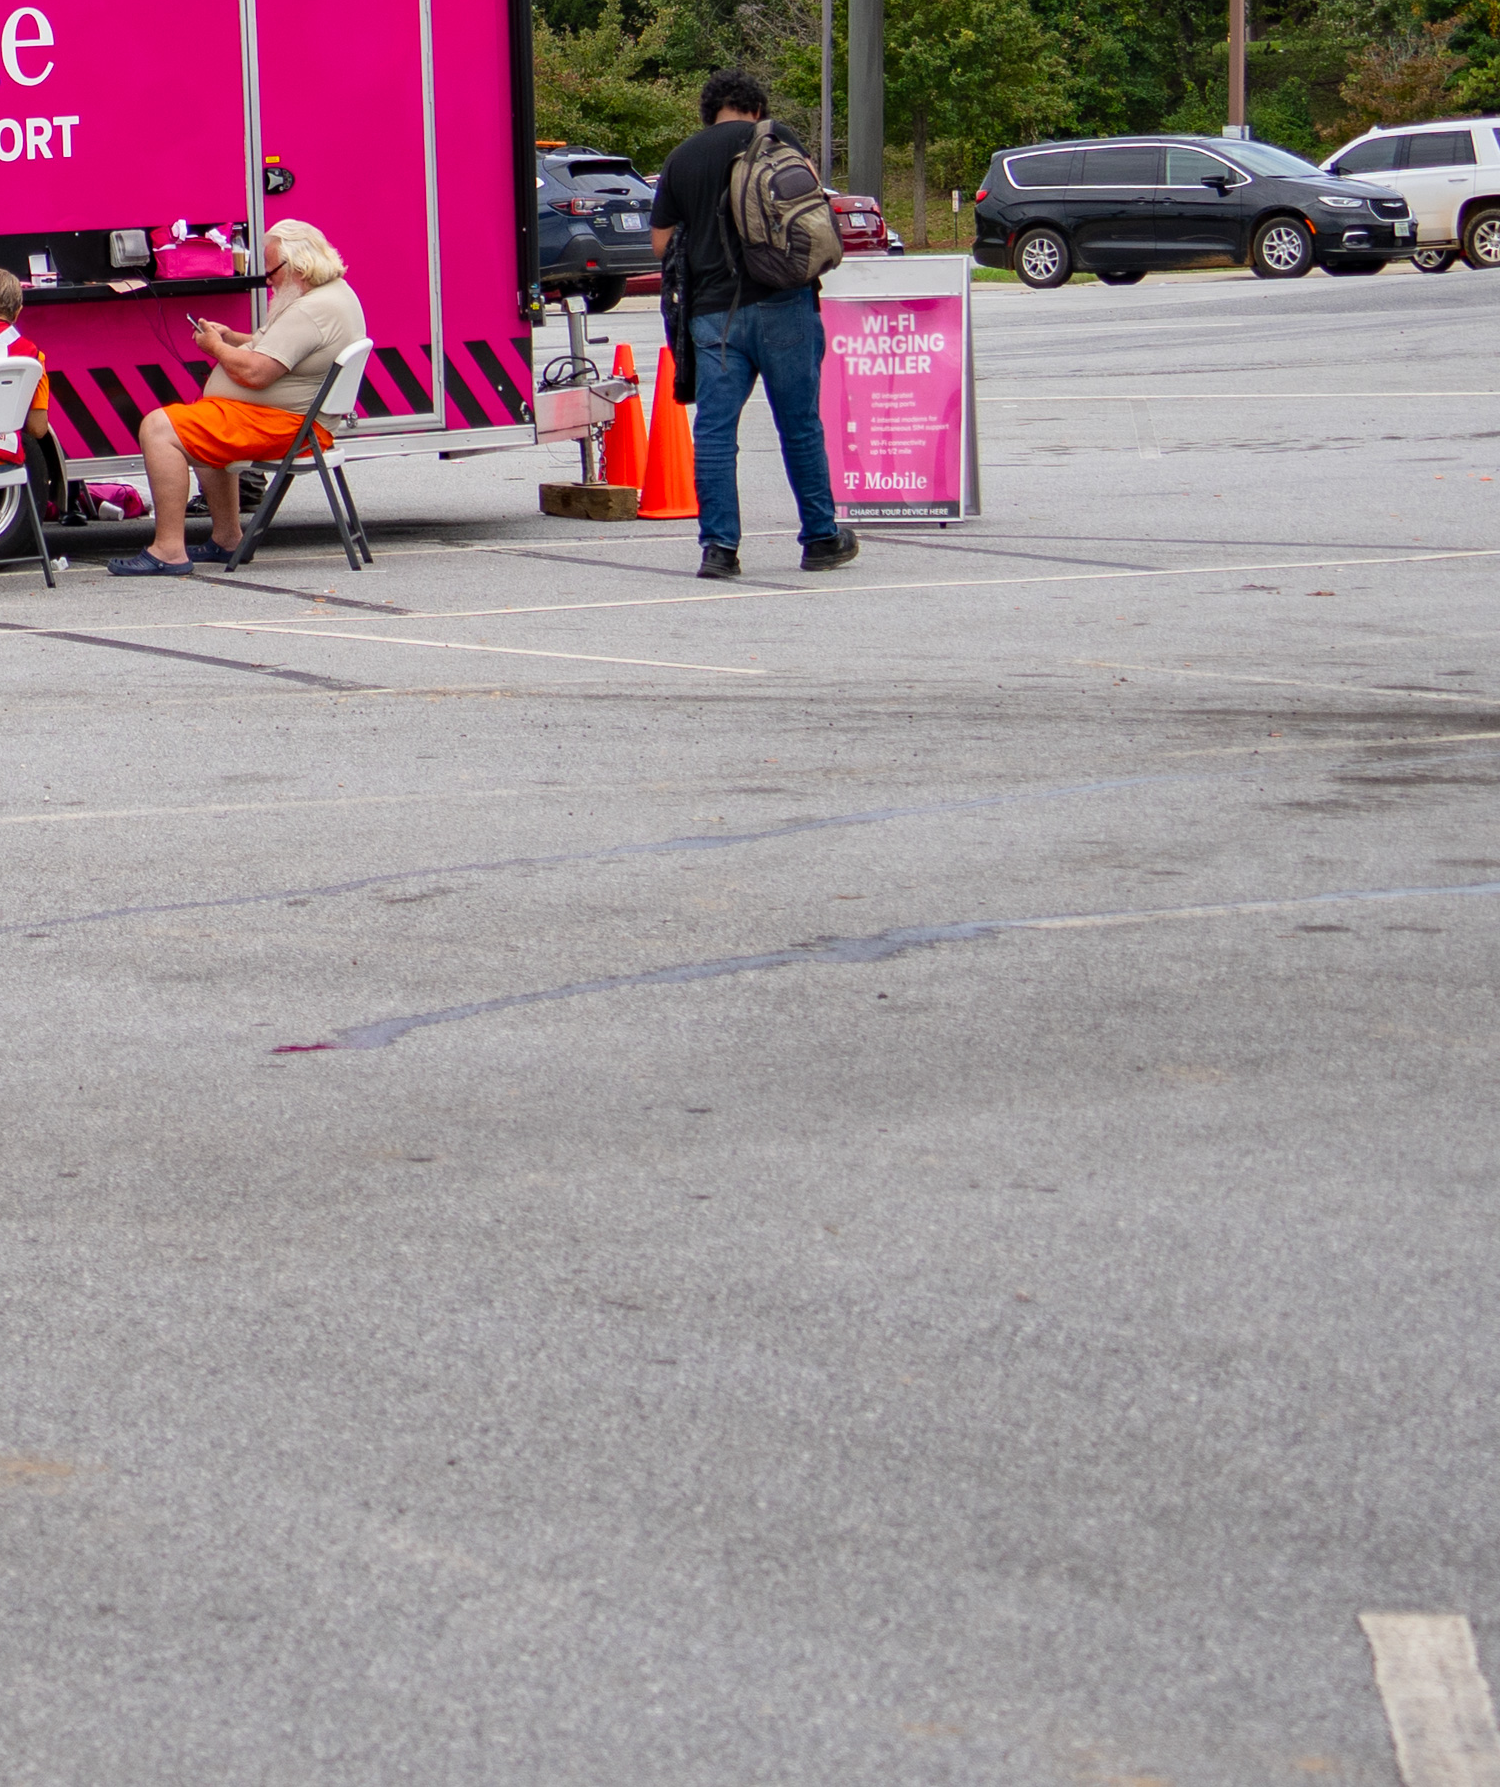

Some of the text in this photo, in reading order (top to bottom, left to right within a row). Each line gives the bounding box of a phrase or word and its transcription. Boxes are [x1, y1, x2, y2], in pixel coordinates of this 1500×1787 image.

[861, 313, 916, 334] WI-FI
[831, 333, 945, 355] CHARGING
[844, 354, 932, 376] TRAILER
[843, 471, 927, 490] T Mobile
[849, 507, 949, 516] CHARGE YOUR DEVICE HERE
